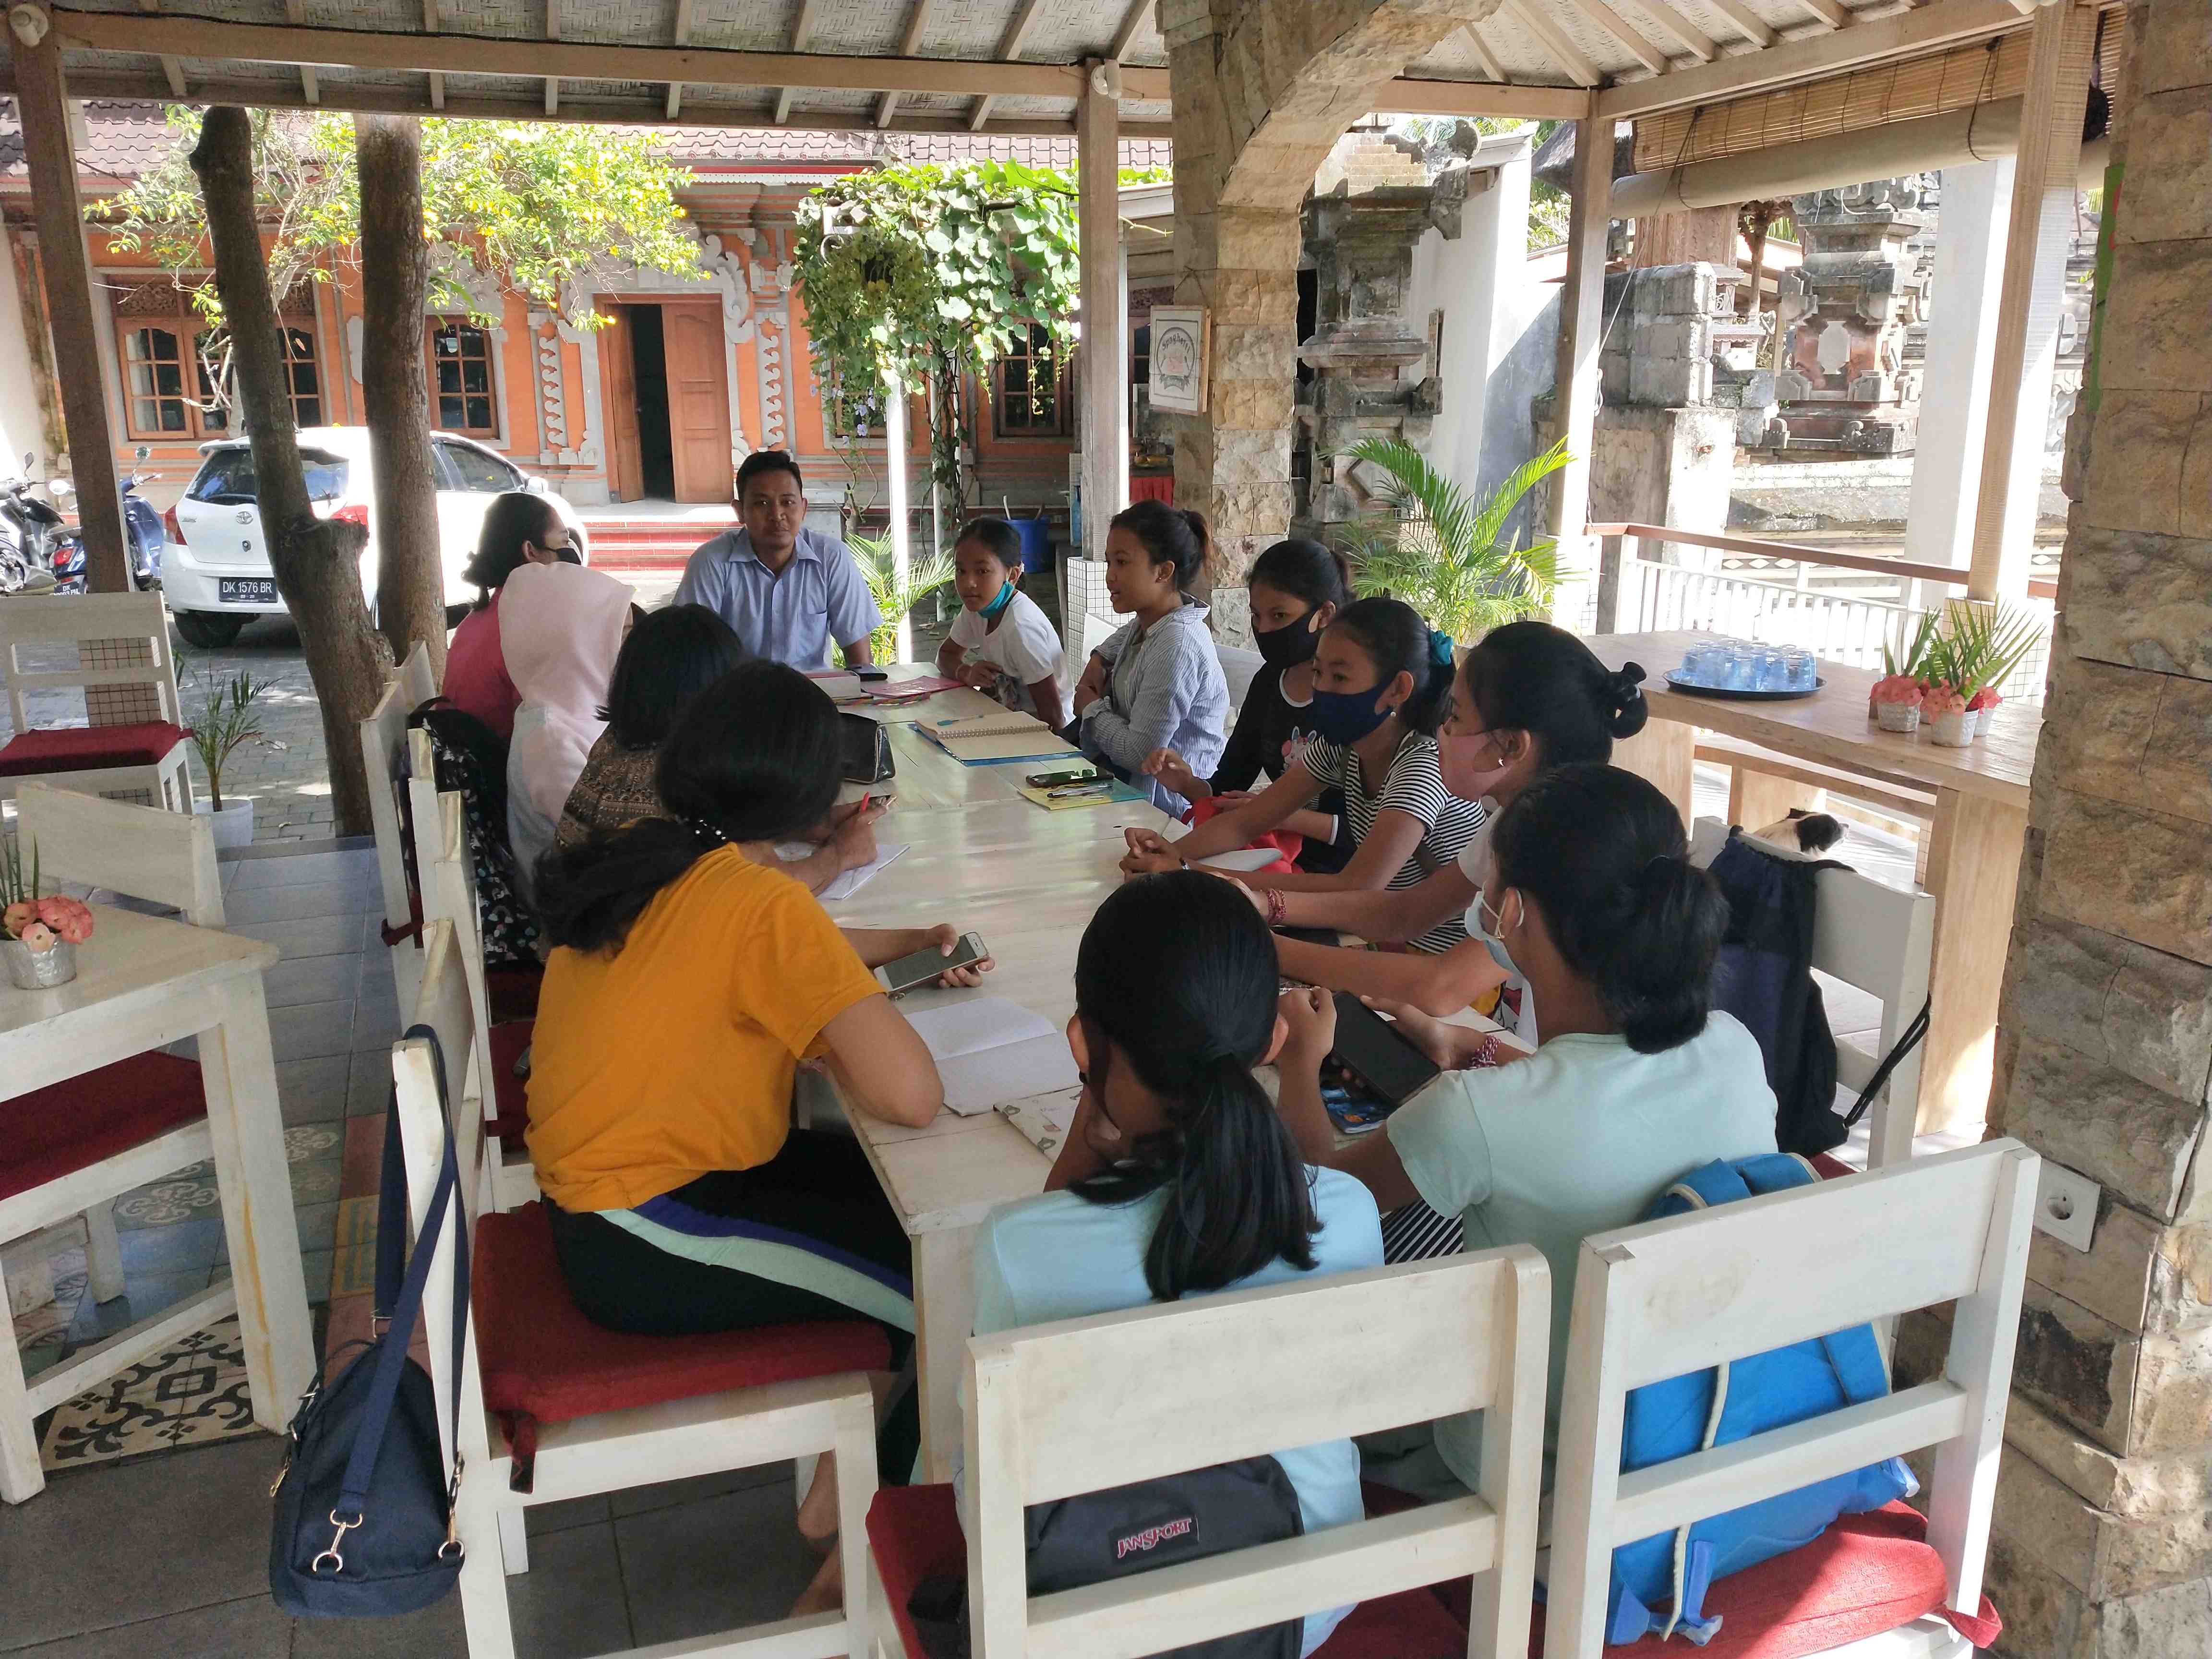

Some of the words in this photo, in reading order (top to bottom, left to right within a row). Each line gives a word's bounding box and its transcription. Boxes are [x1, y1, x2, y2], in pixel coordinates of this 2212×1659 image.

[223, 581, 236, 593] DK
[238, 582, 258, 593] 1576
[260, 582, 272, 593] BR
[1117, 1517, 1192, 1559] JANSPORT
